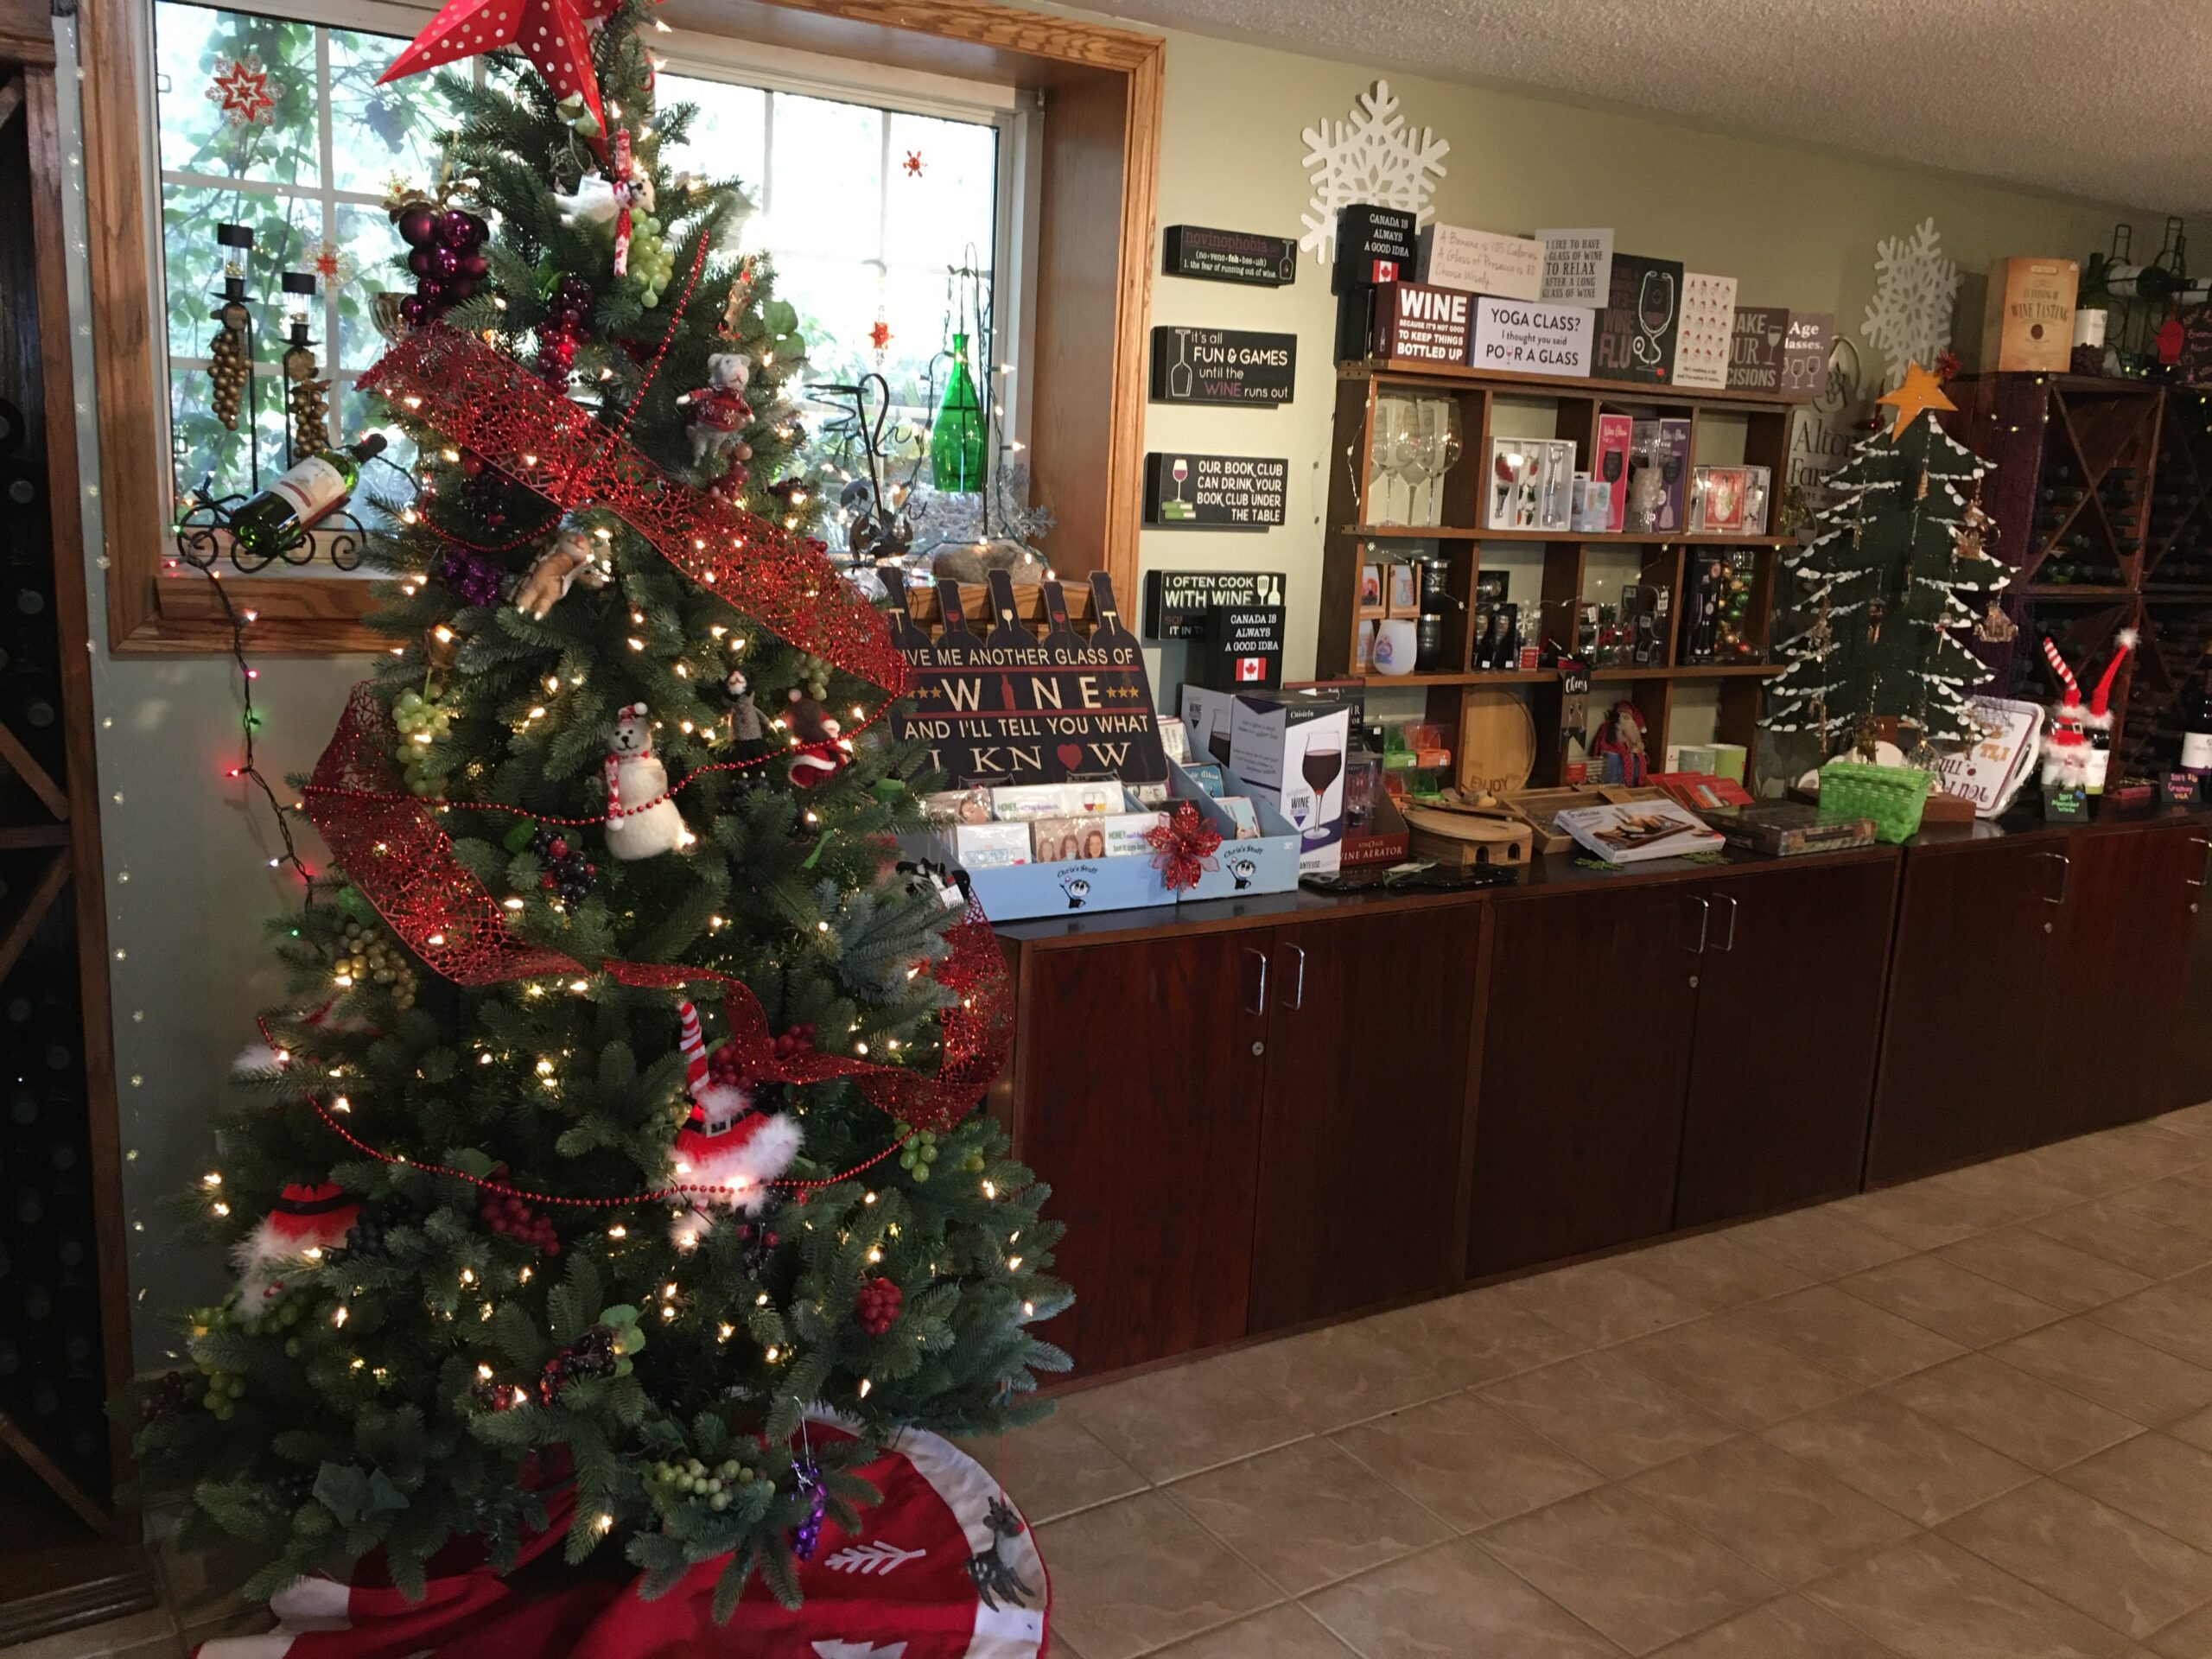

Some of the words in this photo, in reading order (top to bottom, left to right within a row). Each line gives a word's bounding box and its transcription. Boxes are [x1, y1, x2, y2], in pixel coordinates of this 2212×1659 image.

[1370, 213, 1400, 227] CANADA
[1401, 219, 1409, 229] IS
[1373, 229, 1403, 242] ALWAYS
[1363, 241, 1370, 251] A
[1370, 243, 1391, 255] GOOD
[1391, 245, 1410, 257] IDEA
[1551, 239, 1567, 250] LIKE
[1570, 239, 1579, 250] TO
[1582, 239, 1600, 250] HAVE
[1548, 251, 1570, 261] GLASS
[1573, 251, 1581, 261] OF
[1584, 251, 1603, 261] WINE
[1191, 260, 1200, 270] the
[1201, 261, 1213, 271] fear
[1214, 263, 1220, 272] of
[1221, 264, 1244, 276] running
[1245, 267, 1255, 276] out
[1255, 267, 1262, 276] of
[1546, 262, 1560, 276] TO
[1562, 262, 1596, 276] RELAX
[1544, 277, 1566, 287] AFTER
[1569, 277, 1574, 287] A
[1577, 277, 1596, 287] LONG
[1541, 288, 1564, 298] GLASS
[1566, 288, 1575, 298] OF
[1577, 288, 1596, 298] WINE
[1401, 289, 1467, 323] WINE
[2011, 303, 2034, 319] WINE
[2036, 302, 2070, 322] TASTING
[1399, 319, 1425, 330] BECAUSE
[1426, 322, 1436, 331] IT'S
[1437, 323, 1448, 332] NOT
[1449, 324, 1465, 334] GOOD
[1491, 308, 1529, 327] YOGA
[1534, 313, 1580, 332] CLASS?
[1603, 308, 1636, 334] WINE
[1789, 321, 1820, 338] Age
[1192, 331, 1207, 344] it's
[1210, 332, 1223, 345] all
[1399, 329, 1409, 340] TO
[1411, 332, 1432, 343] KEEP
[1434, 334, 1464, 346] THINGS
[1507, 331, 1535, 345] thought
[1538, 336, 1551, 346] you
[1553, 337, 1567, 346] said
[1784, 337, 1824, 351] lasses.
[1193, 346, 1224, 363] FUN
[1227, 348, 1237, 364] &
[1239, 348, 1288, 366] GAMES
[1397, 342, 1446, 359] BOTTLED
[1448, 347, 1463, 360] UP
[1526, 348, 1535, 362] A
[1539, 349, 1580, 366] GLASS
[1598, 332, 1634, 370] FLU
[1199, 367, 1223, 378] until
[1226, 366, 1244, 379] the
[1205, 380, 1242, 397] WINE
[1244, 387, 1268, 398] runs
[1270, 386, 1288, 398] out
[1198, 461, 1221, 474] OUR
[1224, 461, 1256, 477] BOOK
[1257, 463, 1283, 476] CLUB
[1198, 476, 1218, 489] CAN
[1221, 477, 1255, 493] DRINK
[1255, 479, 1281, 492] YOUR
[1197, 492, 1225, 507] BOOK
[1225, 493, 1249, 506] CLUB
[1250, 493, 1281, 507] UNDER
[1231, 508, 1249, 521] THE
[1252, 508, 1281, 522] TABLE
[1166, 575, 1170, 588] I
[1173, 576, 1216, 588] OFTEN
[1218, 576, 1255, 588] COOK
[1165, 590, 1207, 608] WITH
[1211, 590, 1254, 606] WINE
[1230, 614, 1267, 625] CANADA
[1268, 613, 1277, 624] IS
[1169, 626, 1179, 636] IT
[1236, 627, 1271, 639] ALWAYS
[1224, 642, 1231, 652] A
[1233, 641, 1256, 652] GOOD
[1258, 641, 1279, 651] IDEA
[903, 649, 932, 666] IVE
[938, 649, 963, 666] ME
[969, 648, 1051, 666] ANOTHER
[1055, 648, 1109, 664] GLASS
[1113, 648, 1134, 664] OF
[1566, 676, 1588, 694] Cheers
[905, 720, 950, 740] AND
[959, 719, 992, 738] I'LL
[998, 718, 1041, 738] TELL
[1046, 716, 1089, 735] YOU
[1094, 715, 1148, 734] WHAT
[1471, 775, 1509, 792] ENJOY
[1291, 796, 1310, 809] WINE
[1247, 844, 1263, 856] Stuff
[1363, 846, 1402, 860] AERATOR
[1057, 864, 1079, 879] Chris's
[1080, 864, 1098, 874] Stuff
